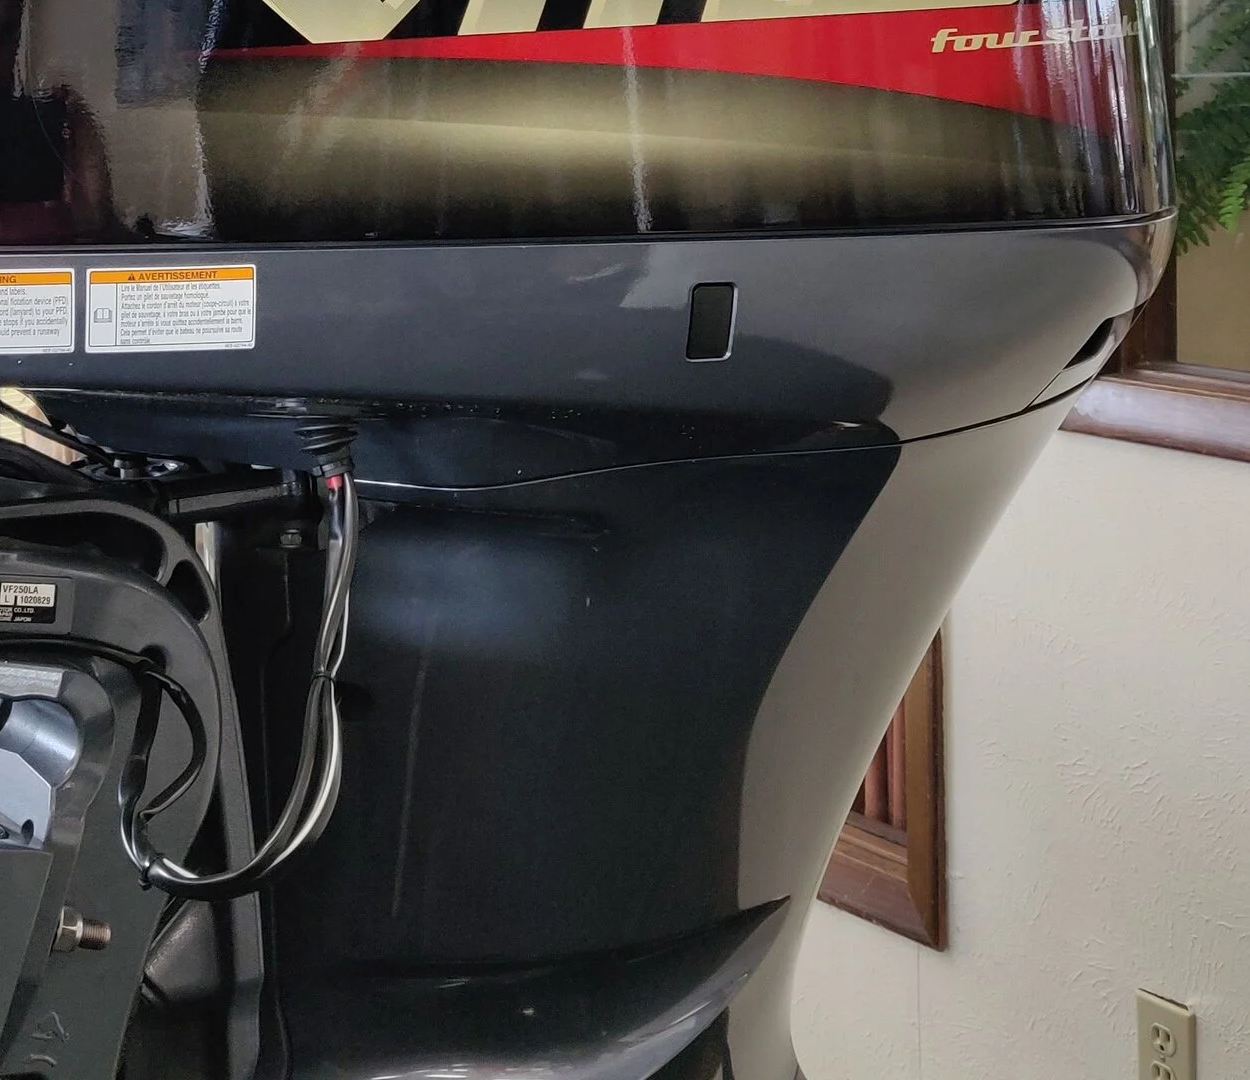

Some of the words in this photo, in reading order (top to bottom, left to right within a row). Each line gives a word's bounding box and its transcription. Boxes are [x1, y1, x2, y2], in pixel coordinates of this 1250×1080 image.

[930, 27, 1040, 53] four
[138, 271, 218, 281] AVERTISSEMENT
[3, 585, 38, 595] VF250LA
